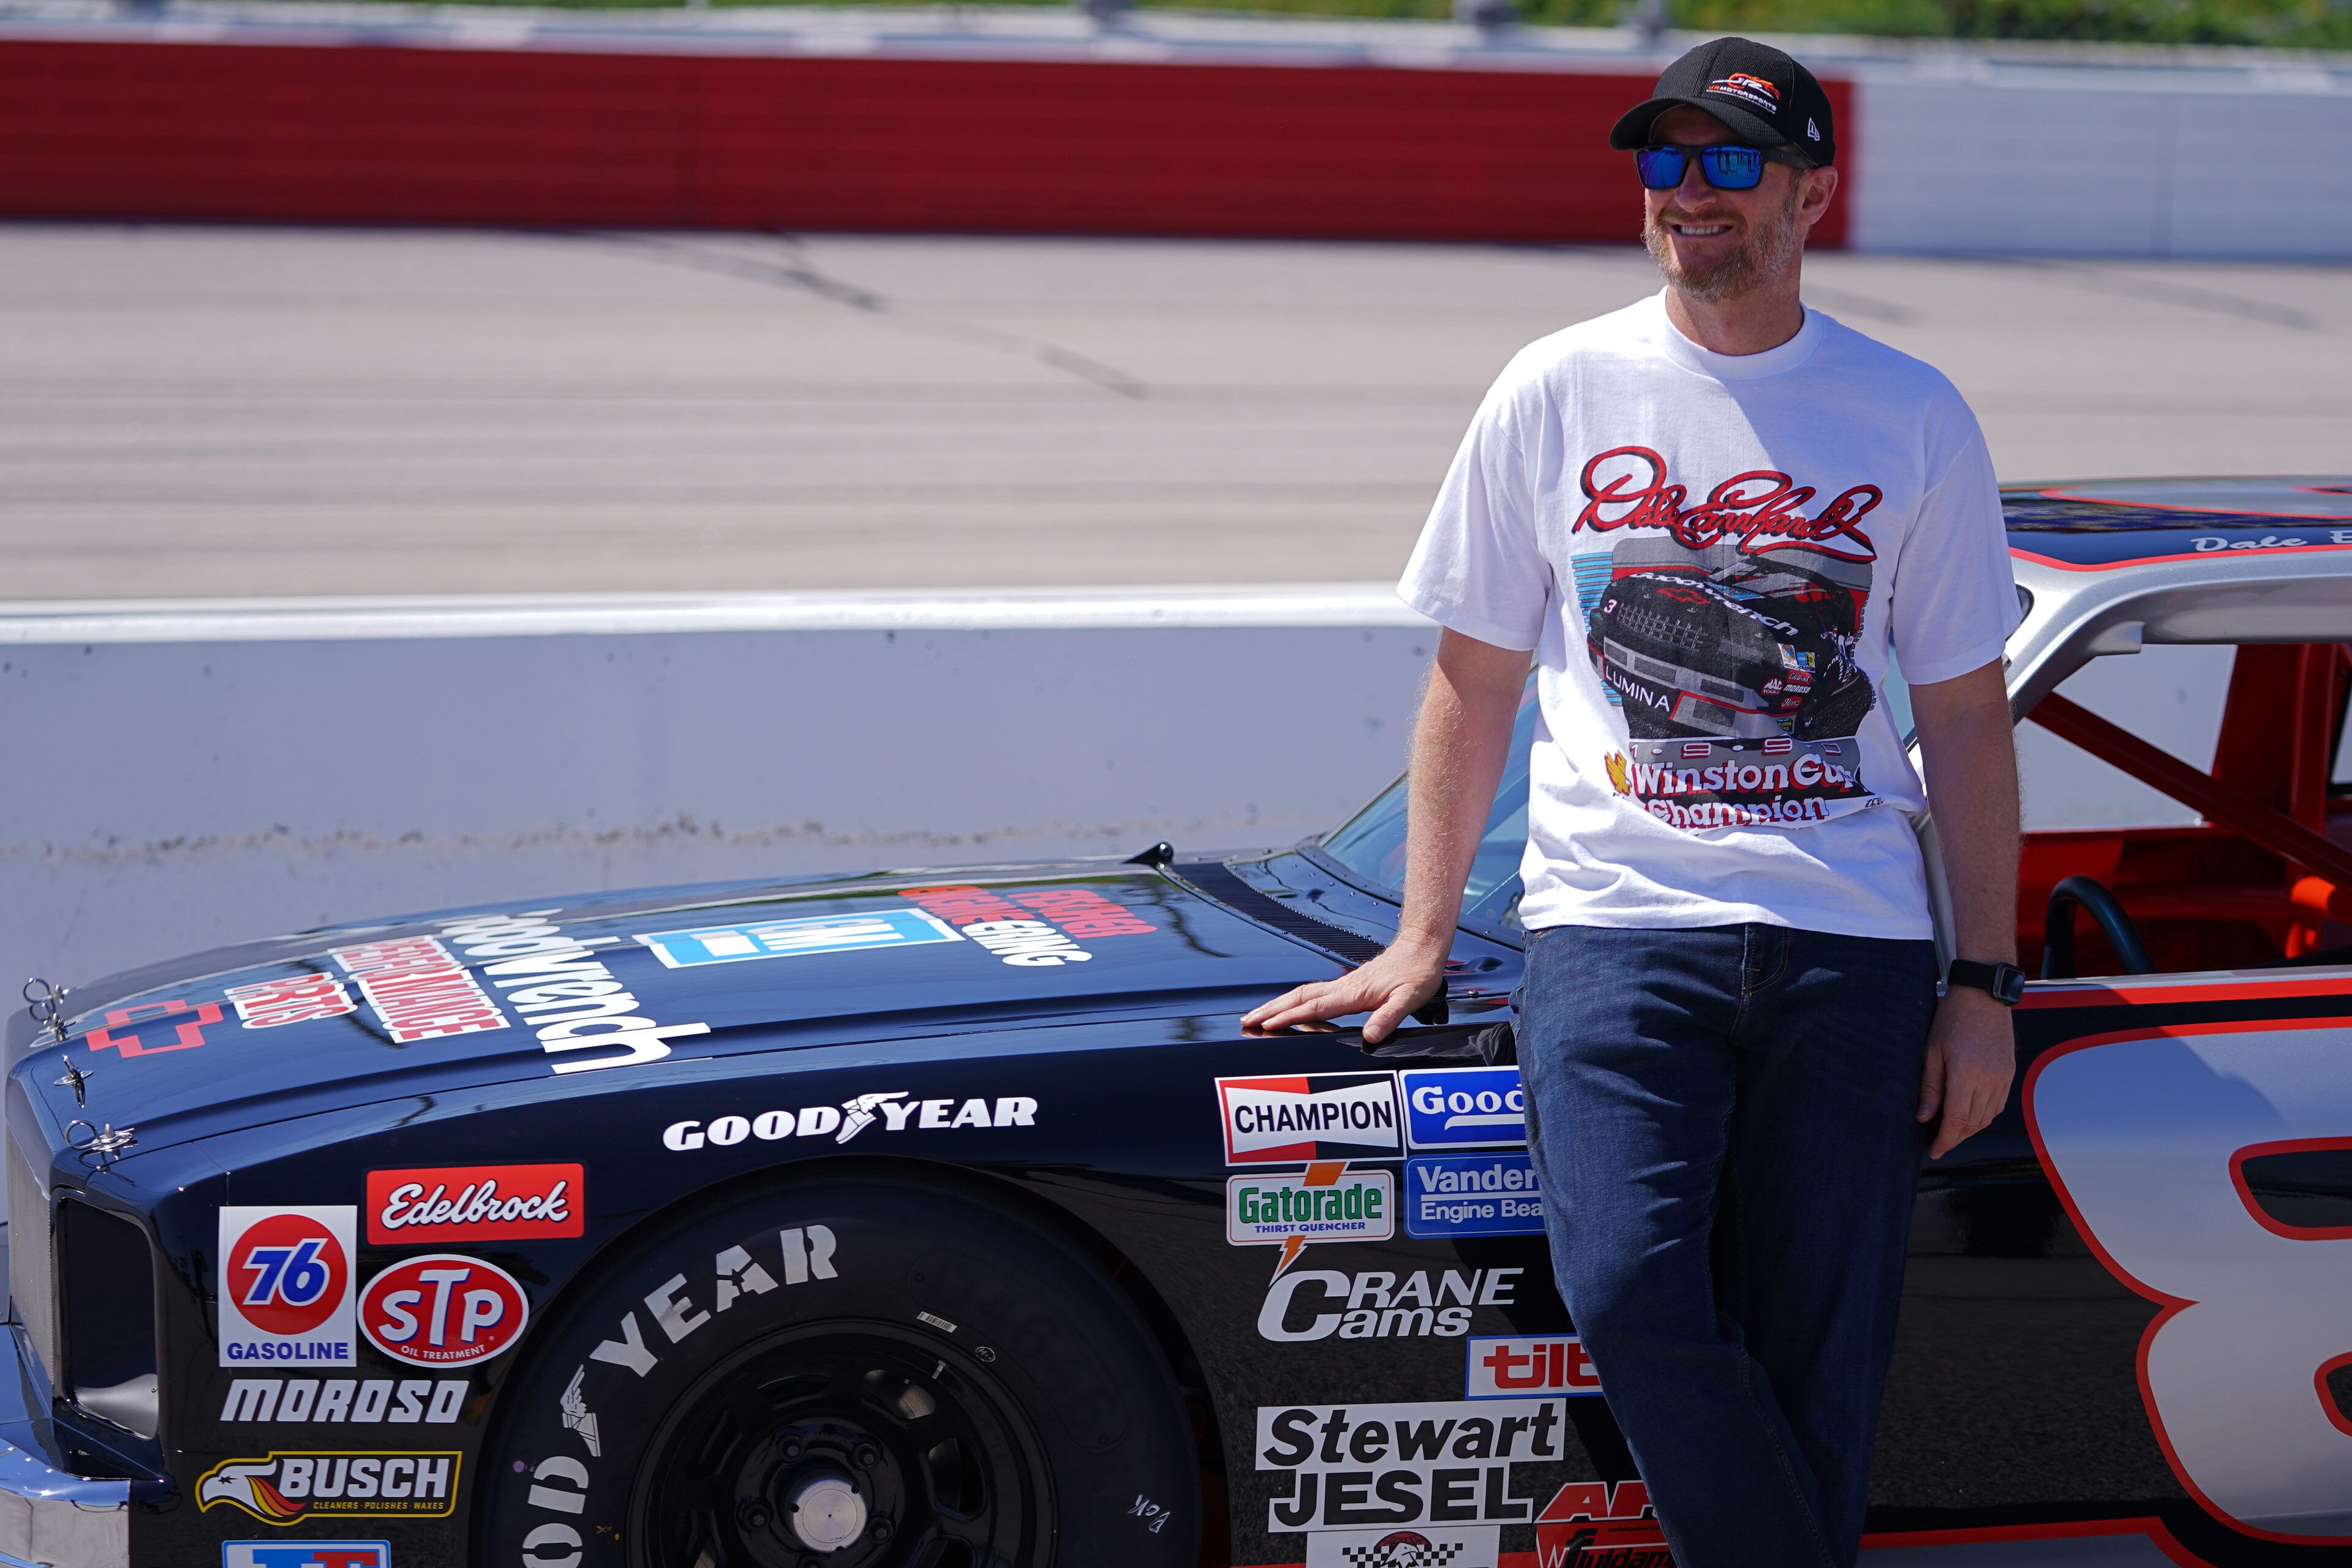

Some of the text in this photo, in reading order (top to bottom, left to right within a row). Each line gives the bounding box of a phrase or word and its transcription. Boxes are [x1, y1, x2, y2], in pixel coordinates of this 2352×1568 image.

[2190, 535, 2308, 552] Dale
[1604, 599, 1618, 614] 3
[1605, 665, 1671, 712] LUMINA
[1783, 684, 1811, 693] MOROSO
[1630, 758, 1790, 797] Winston
[1648, 794, 1829, 830] Champion
[758, 918, 905, 952] GM
[224, 971, 358, 1030] PARTS
[328, 935, 510, 1044] PERFORMANCE
[1234, 1101, 1393, 1134] CHAMPION
[1416, 1164, 1538, 1193] Vander
[381, 1180, 569, 1231] Edelbrock
[1239, 1183, 1383, 1224] Gatorade
[1421, 1201, 1495, 1224] Engine
[1255, 1221, 1366, 1234] THIRST QUENCHER
[241, 1237, 331, 1308] 76
[378, 1268, 505, 1347] STP
[227, 1342, 349, 1360] GASOLINE
[401, 1344, 485, 1360] OIL TREATMENT
[220, 1379, 469, 1423] MOROSO
[1262, 1403, 1558, 1467] Stewart
[279, 1458, 450, 1498] BUSCH
[313, 1501, 444, 1510] CLEANERS POLISHES WAXES
[1274, 1468, 1528, 1528] JESEL
